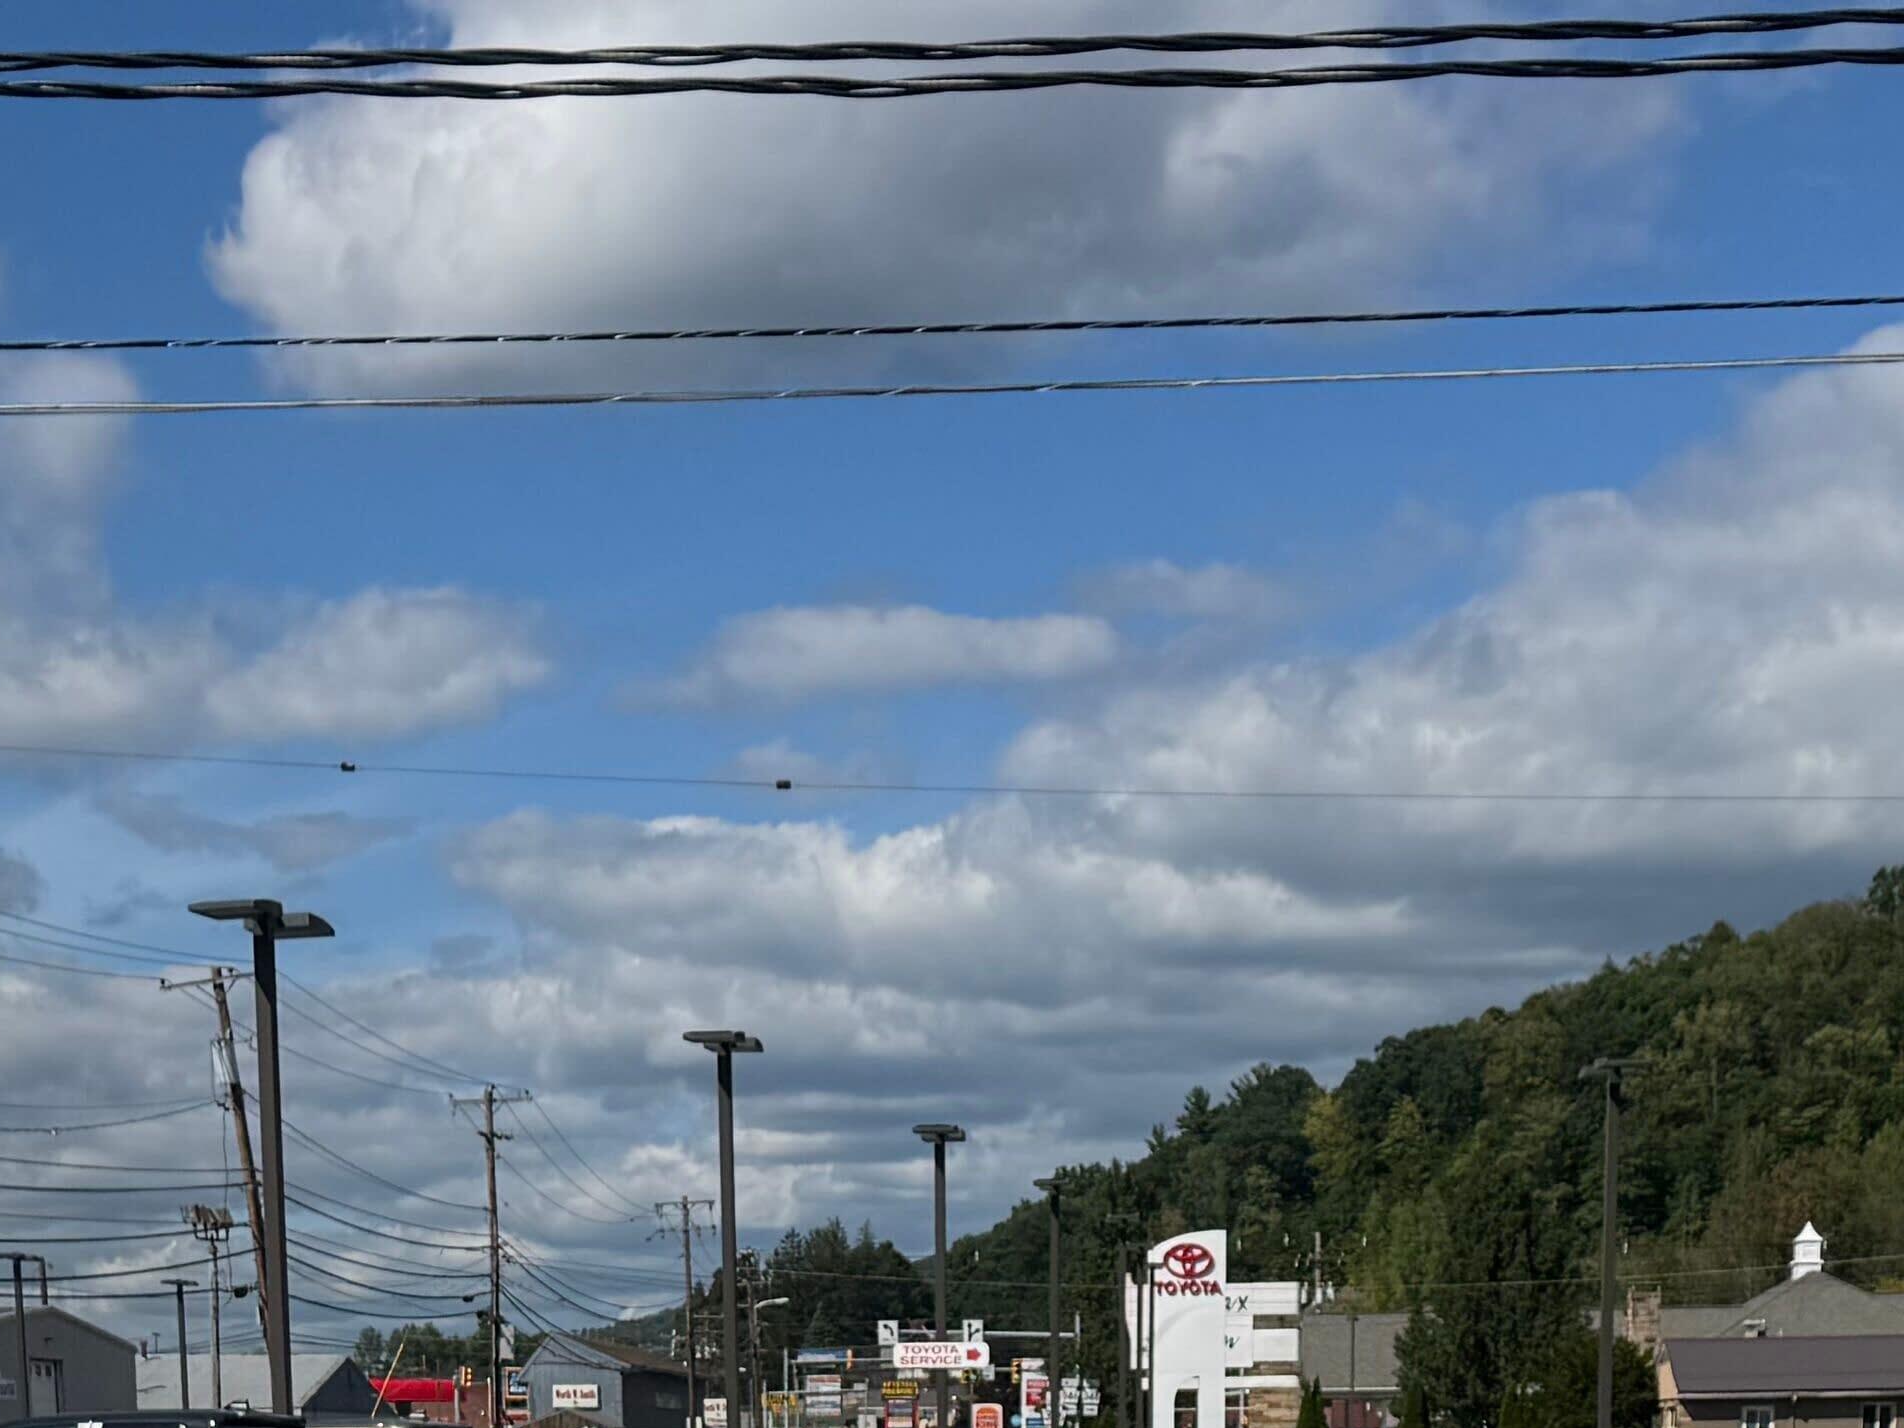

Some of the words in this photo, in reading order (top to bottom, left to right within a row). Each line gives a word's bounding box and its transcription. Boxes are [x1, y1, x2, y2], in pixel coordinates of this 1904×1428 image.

[1155, 1280, 1224, 1297] TOYOTA
[903, 1345, 959, 1354] TOYOTA
[900, 1355, 962, 1365] SERVICE
